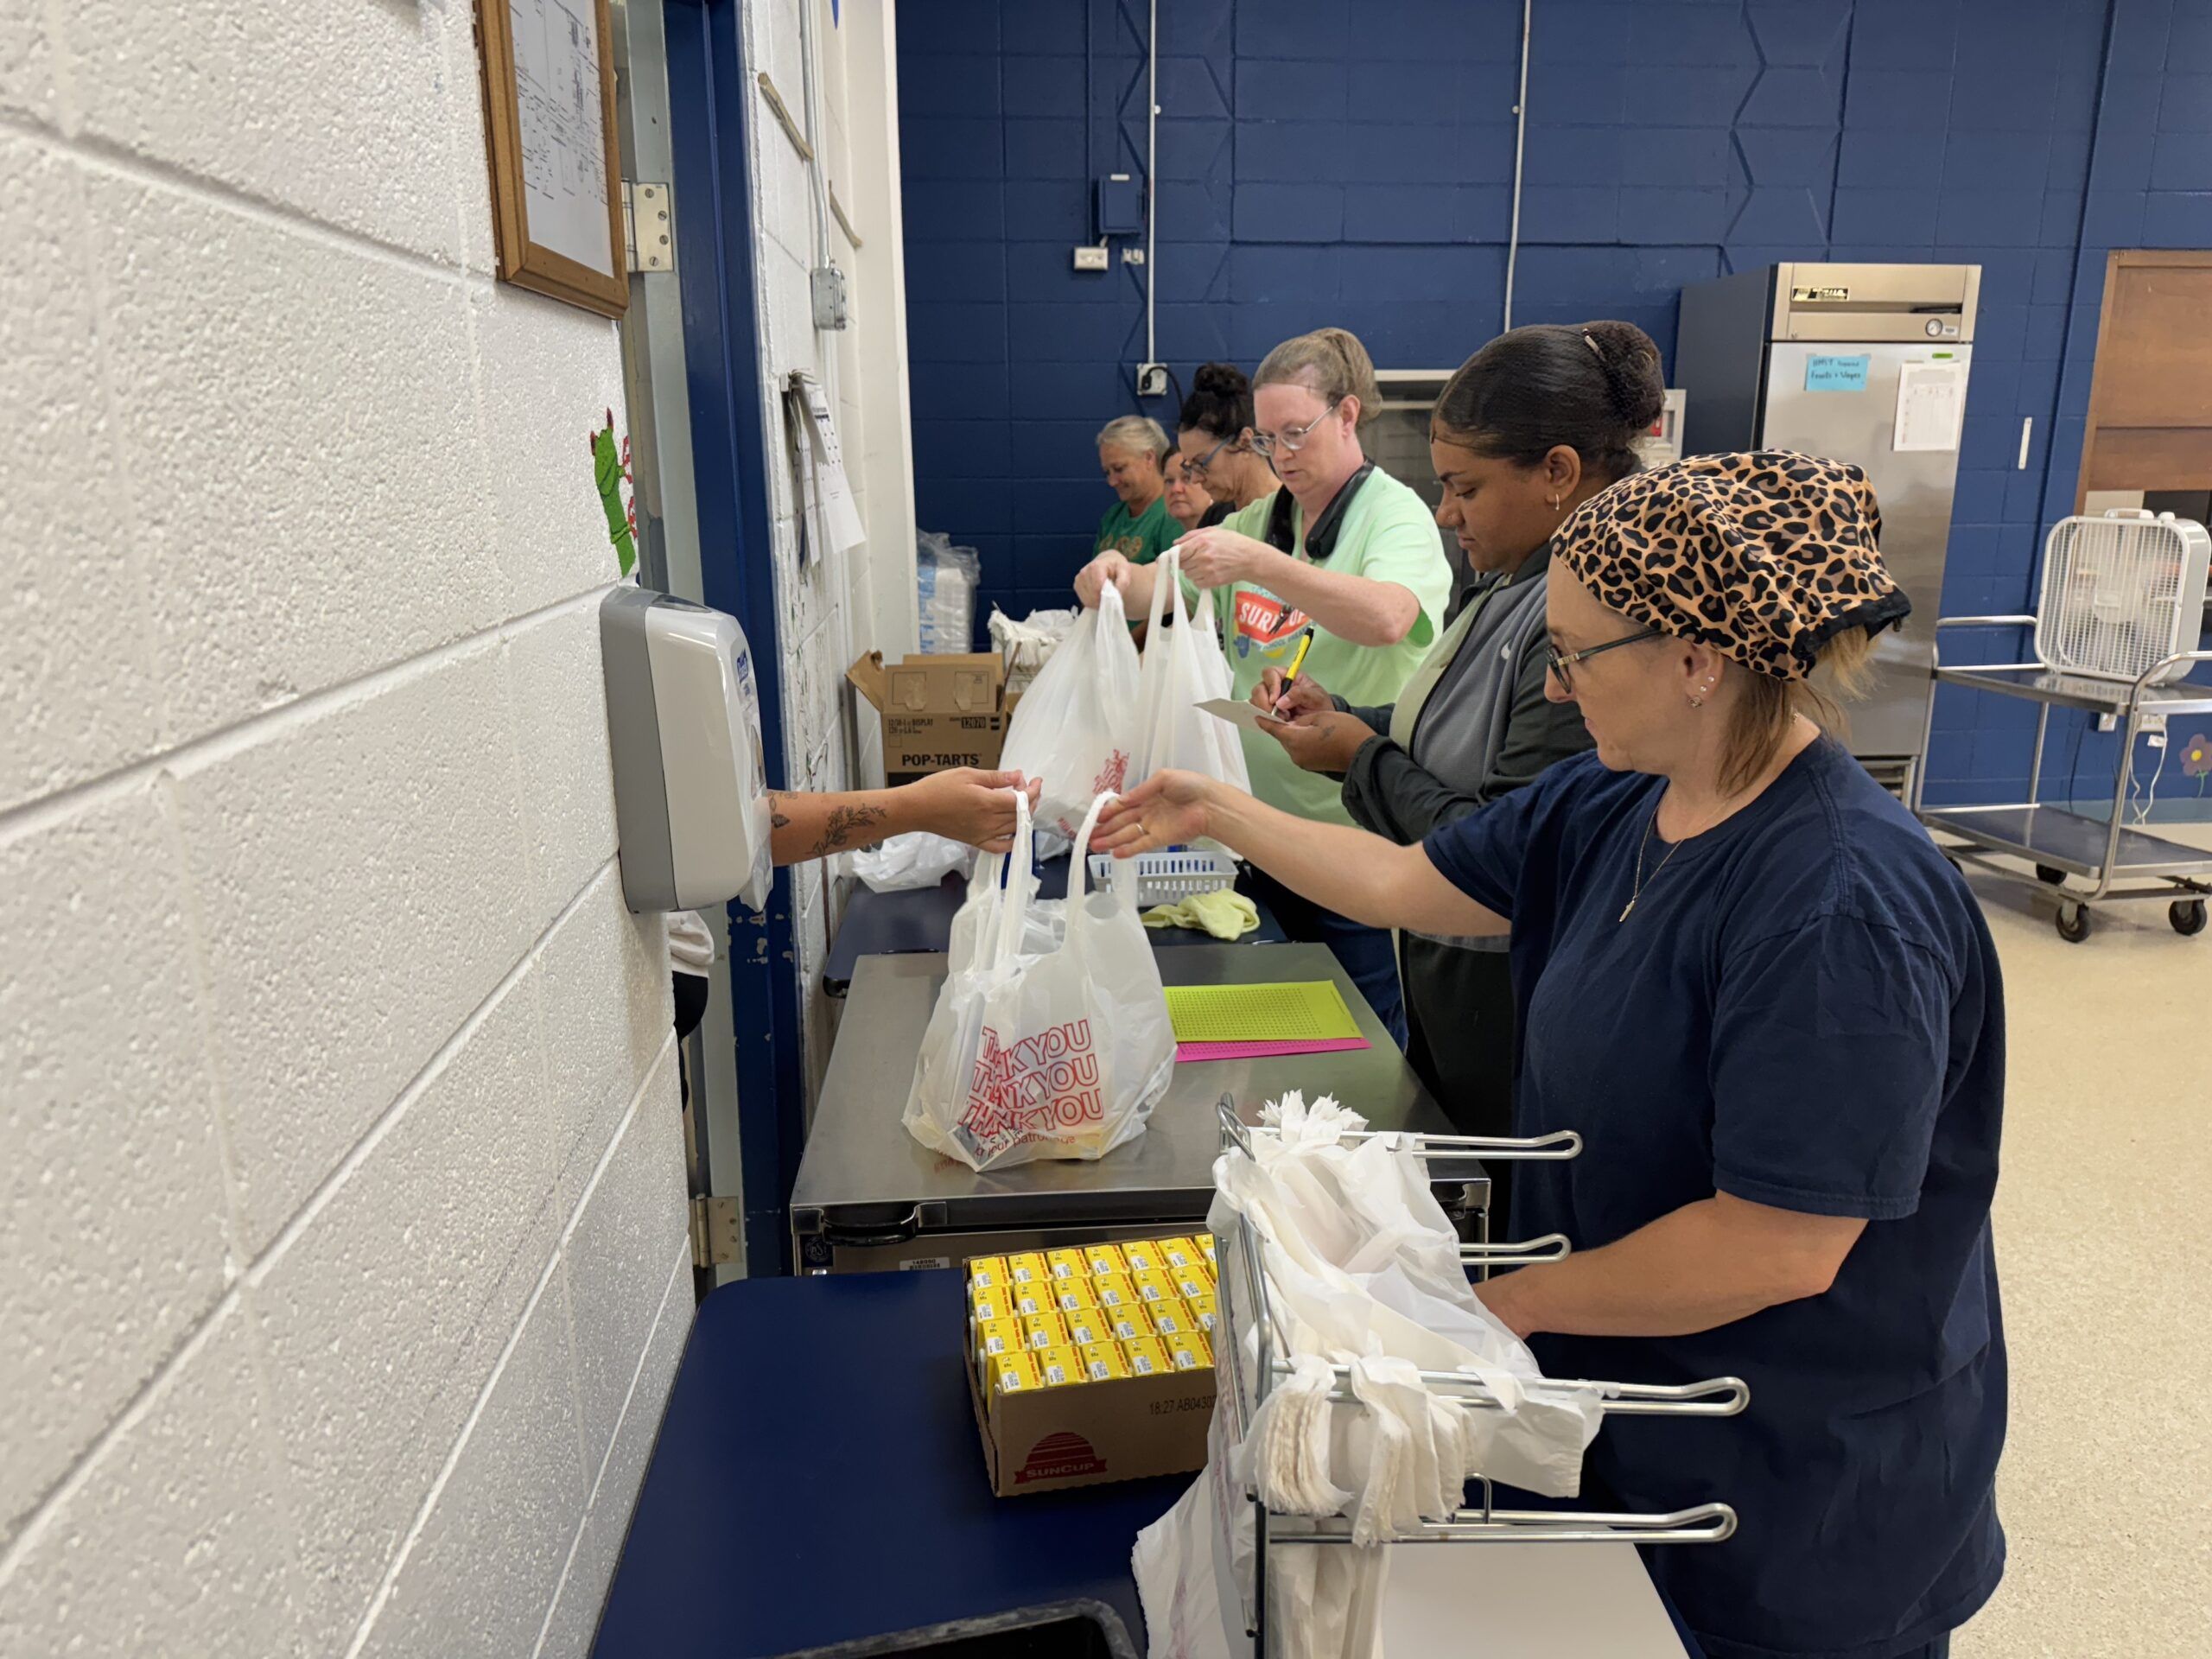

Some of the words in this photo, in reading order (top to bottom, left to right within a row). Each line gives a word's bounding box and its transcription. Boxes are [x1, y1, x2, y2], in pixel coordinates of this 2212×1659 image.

[963, 717, 985, 728] 12070
[902, 753, 979, 766] POP-TARTS
[1022, 1019, 1091, 1066] YOU
[1030, 1053, 1099, 1100] YOU
[1038, 1088, 1104, 1132] YOU
[1149, 1400, 1174, 1415] 18:27
[1026, 1462, 1095, 1478] SUNCUP
